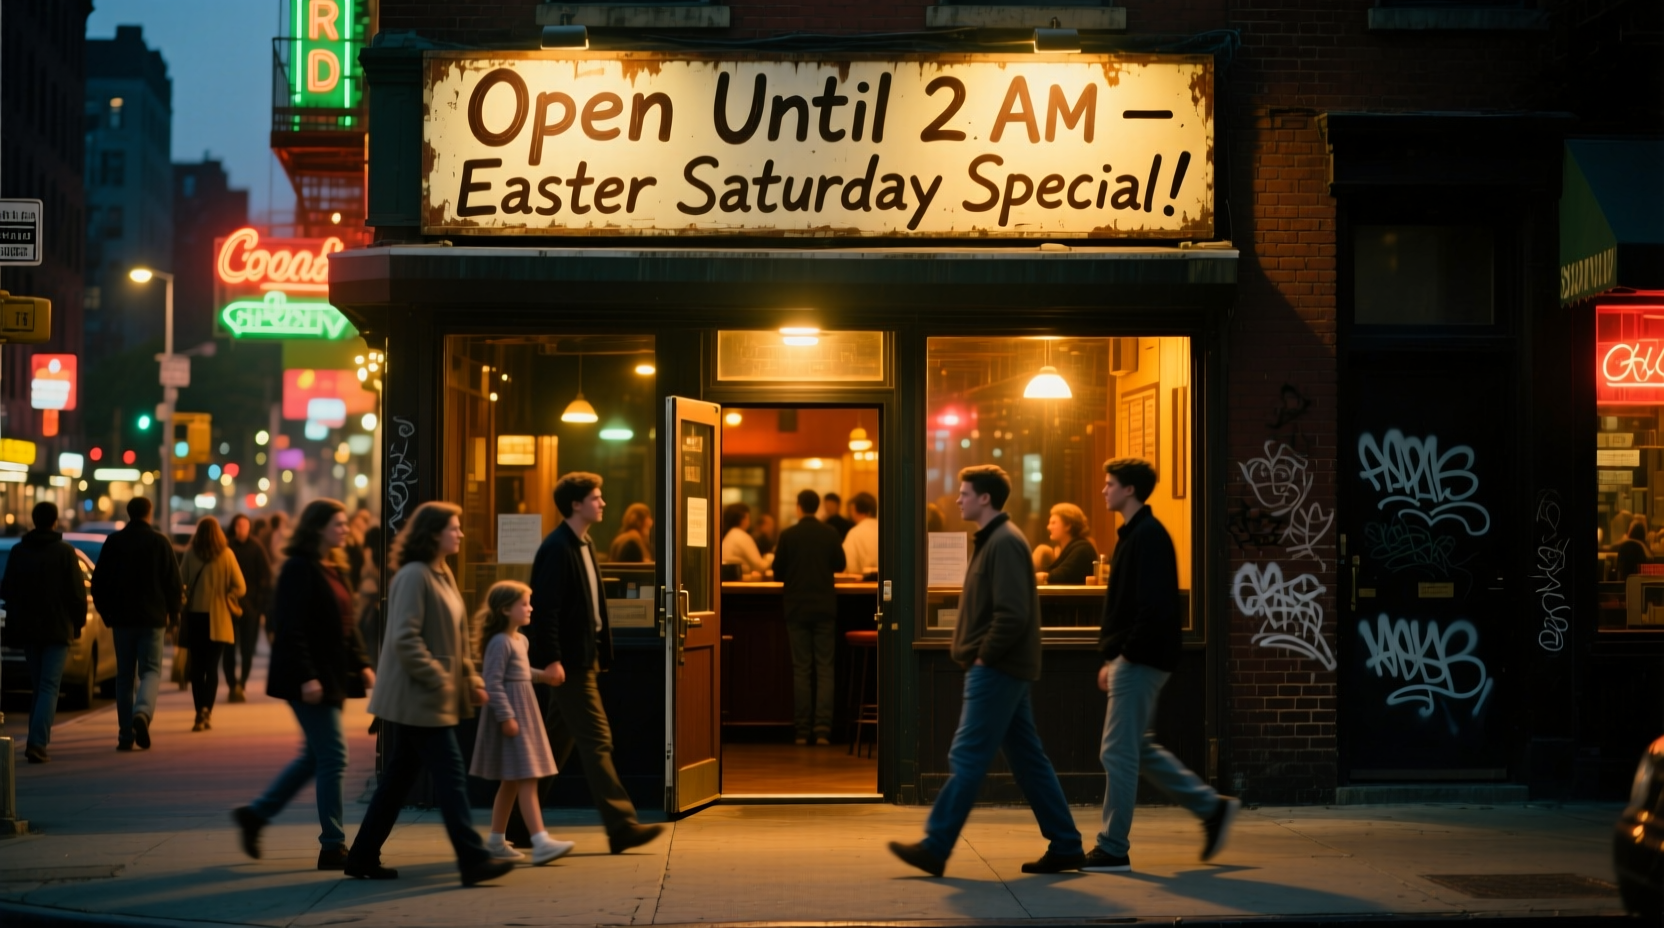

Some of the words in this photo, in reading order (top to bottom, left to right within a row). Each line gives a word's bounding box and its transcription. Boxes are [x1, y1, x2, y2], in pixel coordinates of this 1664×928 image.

[468, 69, 673, 166] Open
[714, 72, 891, 145] Until
[920, 76, 966, 143] 2
[990, 79, 1097, 144] AM
[457, 158, 657, 217] Easter
[676, 154, 942, 230] Saturday
[962, 151, 1191, 228] Special!
